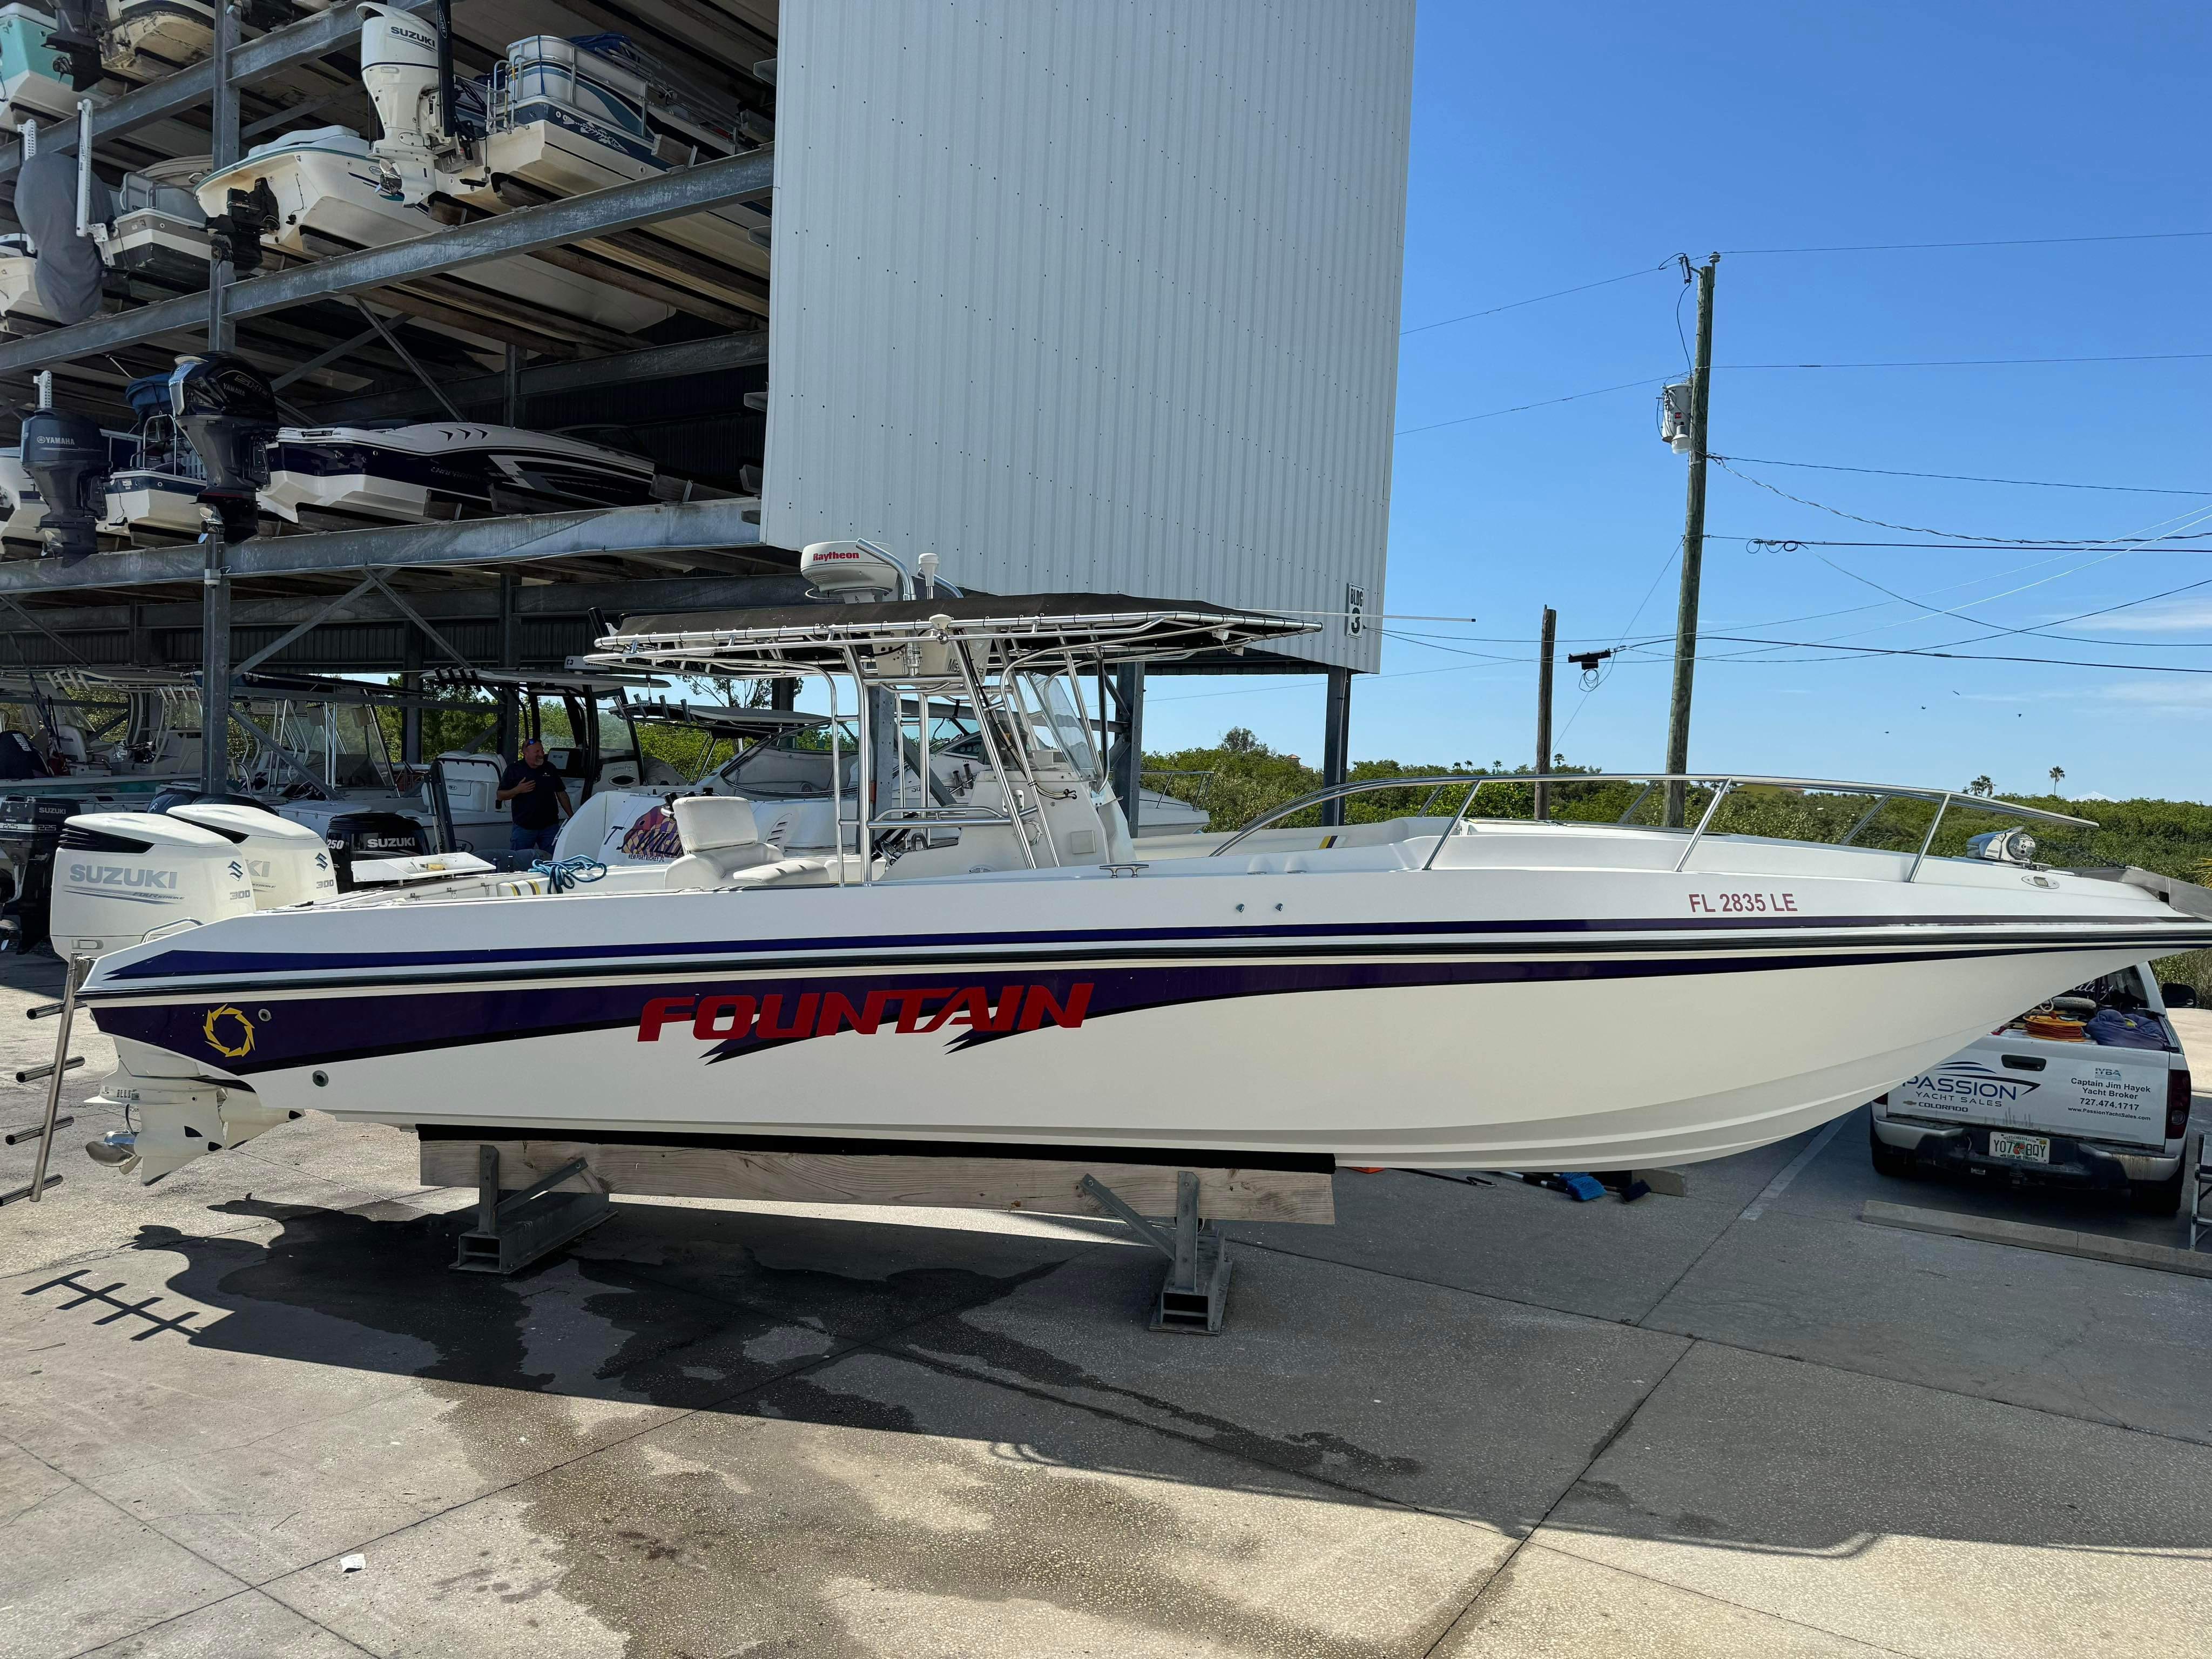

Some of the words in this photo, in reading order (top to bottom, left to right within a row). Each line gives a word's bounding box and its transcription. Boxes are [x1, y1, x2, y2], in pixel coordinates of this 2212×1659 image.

[390, 26, 435, 48] SUZUKI
[45, 436, 75, 445] YAMAHA
[813, 551, 860, 562] Raytheon
[1350, 588, 1363, 607] BLDG
[1351, 607, 1360, 634] 3
[327, 839, 345, 849] 250
[367, 837, 415, 848] SUZUKI
[70, 864, 178, 889] SUZUKI
[316, 879, 334, 889] 300
[230, 889, 250, 900] 300
[1689, 894, 1716, 913] FL
[1719, 893, 1766, 912] 2835
[1770, 893, 1798, 912] LE
[637, 983, 1094, 1042] FOUNTAIN
[2071, 1078, 2103, 1087] Captain
[2124, 1084, 2151, 1092] Hayek
[1916, 1091, 1955, 1101] YACHT
[1960, 1097, 2002, 1107] SALES
[2082, 1087, 2106, 1096] Yacht
[2108, 1090, 2138, 1099] Broker
[1918, 1102, 1968, 1112] COLORADO
[2080, 1098, 2140, 1111] 727.474.1717
[2068, 1107, 2151, 1121] www.PassionYachtSales.com
